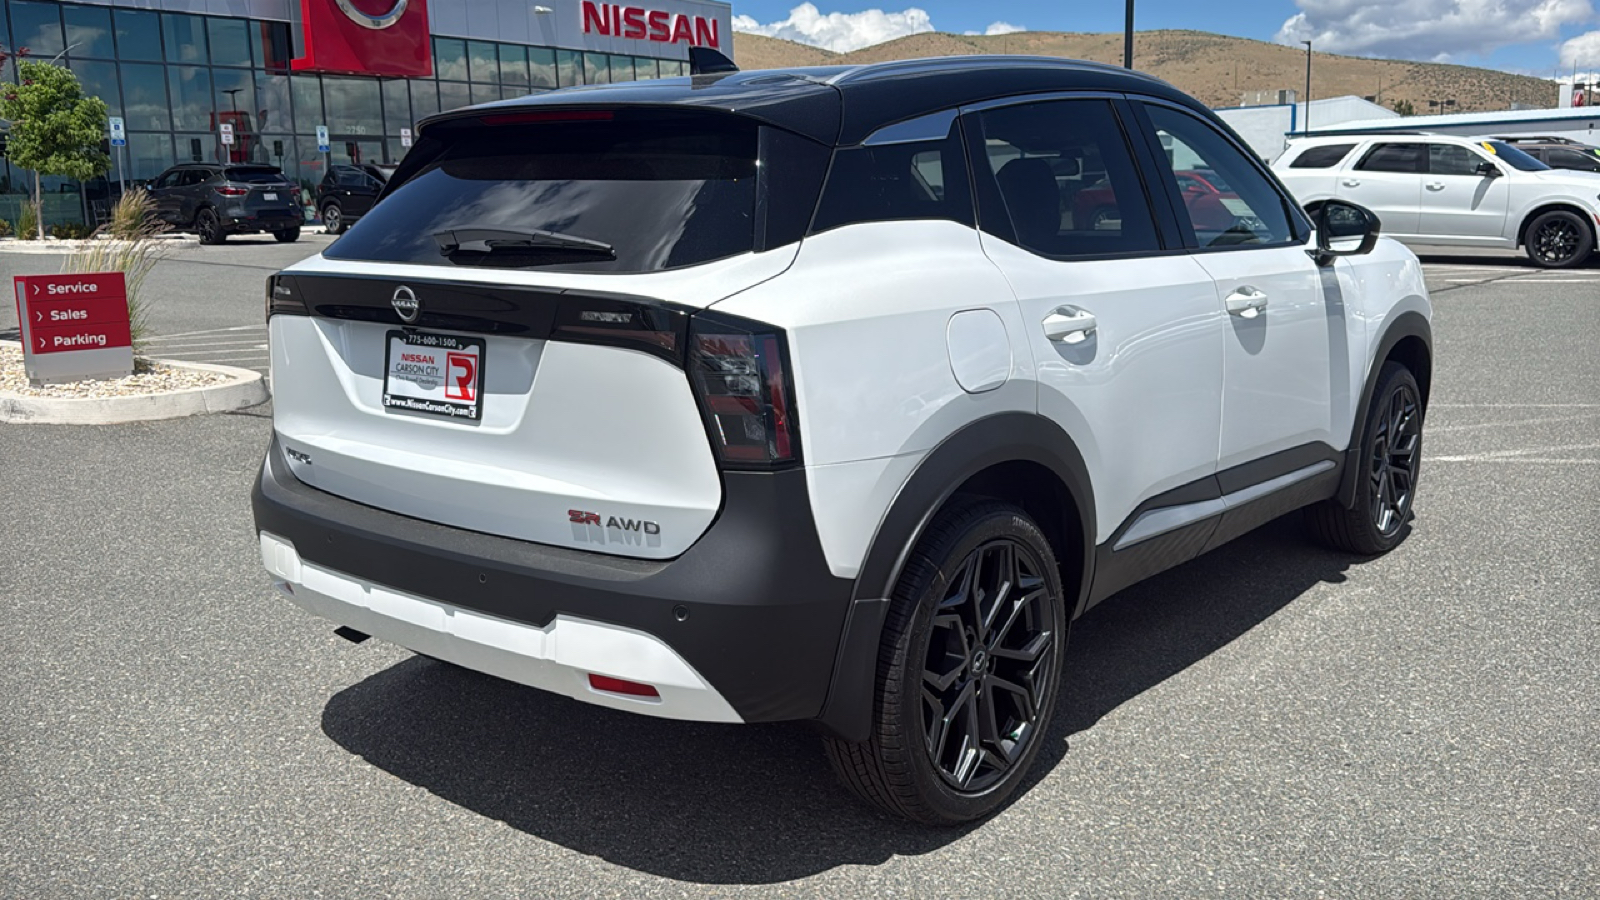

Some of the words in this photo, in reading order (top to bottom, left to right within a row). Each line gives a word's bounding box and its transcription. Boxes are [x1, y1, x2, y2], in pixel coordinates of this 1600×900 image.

[581, 0, 720, 48] NISSAN
[47, 281, 98, 295] Service
[50, 309, 88, 321] Sales
[54, 333, 107, 346] Parking
[408, 334, 457, 347] 775-600-1500
[401, 353, 435, 365] NISSAN
[395, 363, 424, 375] CARSON
[425, 365, 440, 376] CITY
[391, 399, 469, 416] www.NissanCarsonCity.com
[568, 509, 602, 527] SR
[606, 516, 661, 535] AWD
